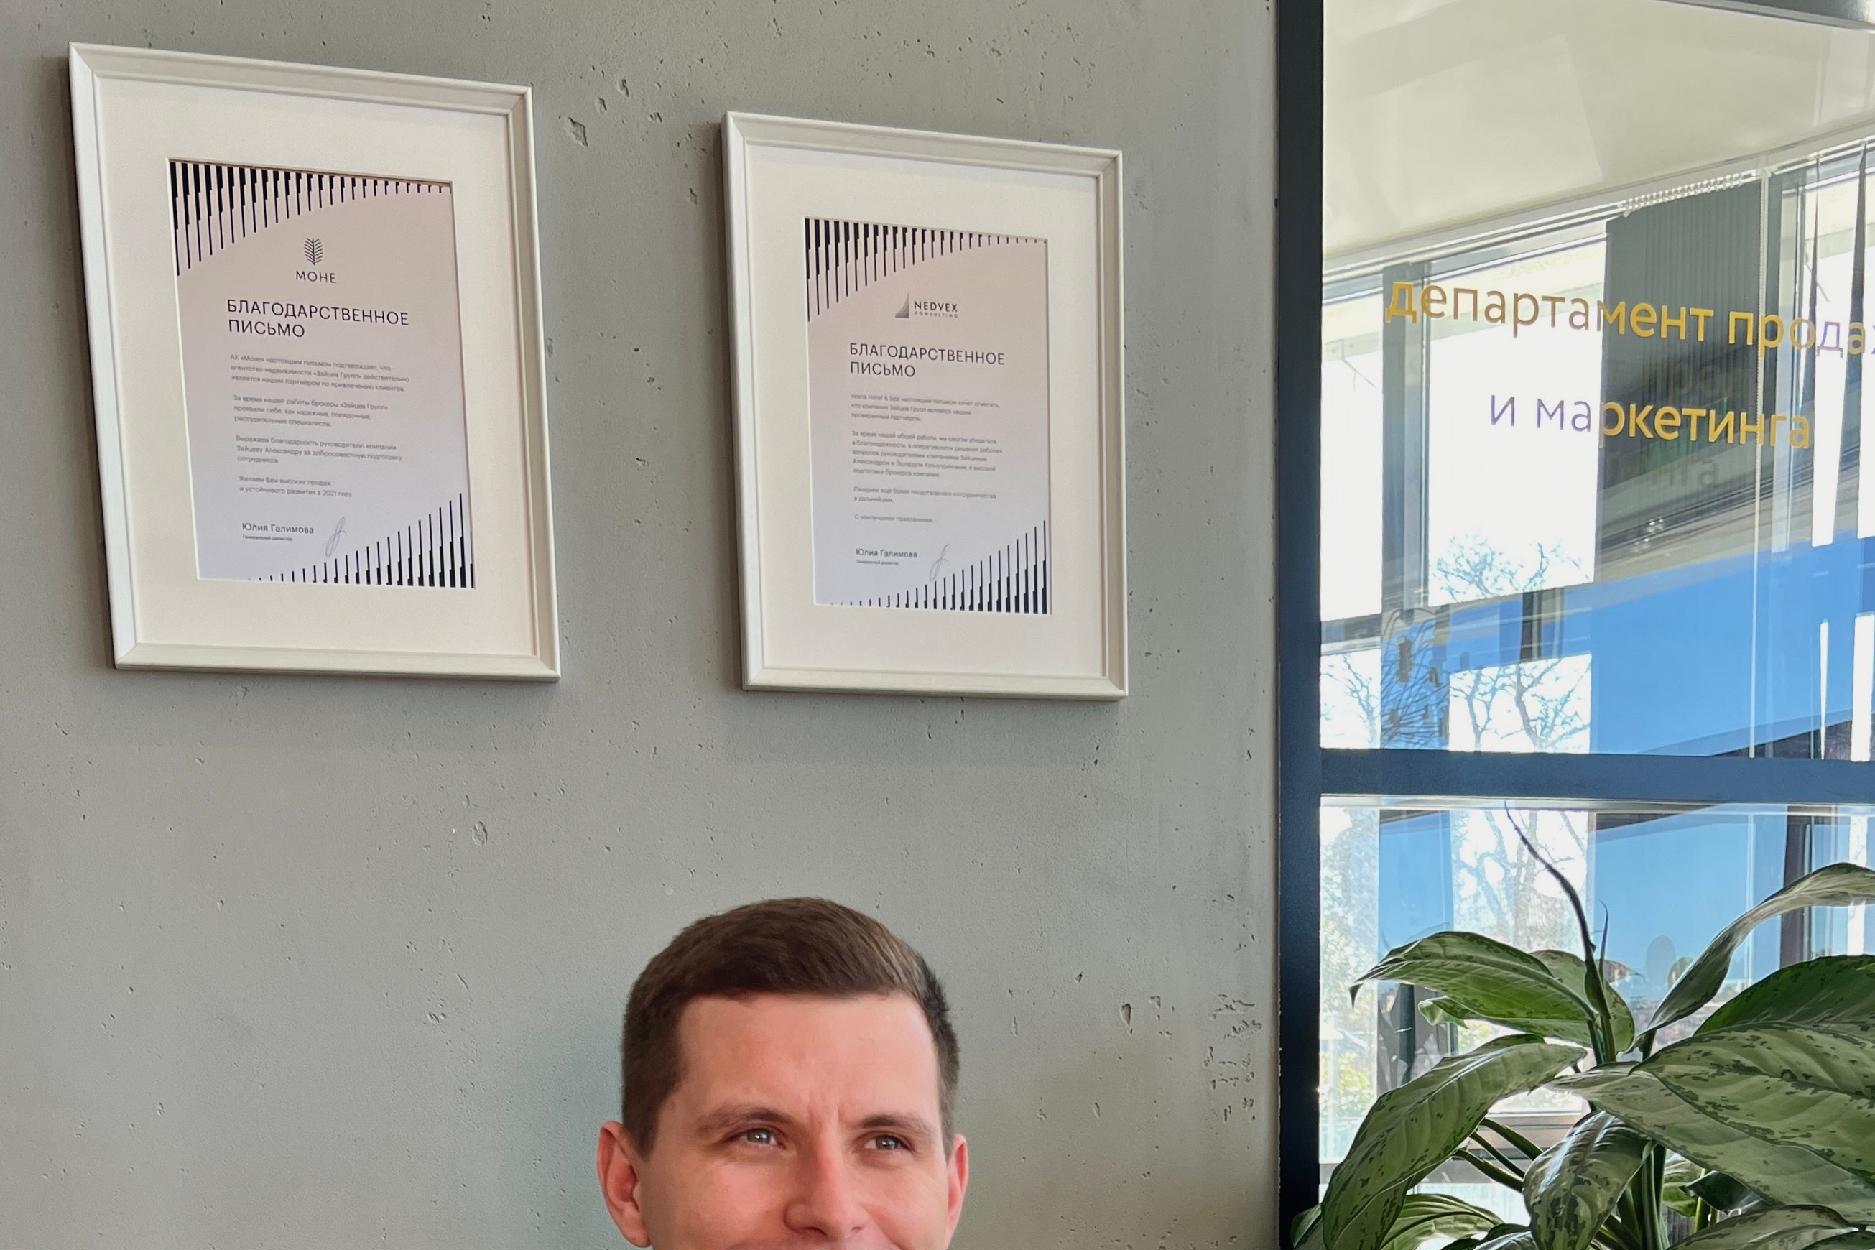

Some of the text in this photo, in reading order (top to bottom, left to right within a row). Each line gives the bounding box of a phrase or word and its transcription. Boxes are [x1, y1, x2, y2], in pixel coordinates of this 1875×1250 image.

[295, 270, 337, 284] МОНЕ
[226, 298, 410, 326] БЛАГОДАРСТВЕННОЕ
[914, 301, 959, 314] NEDVEX
[228, 318, 306, 338] ПИСЬМО
[1384, 281, 1875, 358] департамент прода
[850, 342, 1006, 366] БЛАГОДАРСТВЕННОЕ
[850, 361, 917, 378] ПИСЬМО
[1489, 393, 1811, 449] и маркетинга
[242, 521, 314, 535] Юлия Галимова
